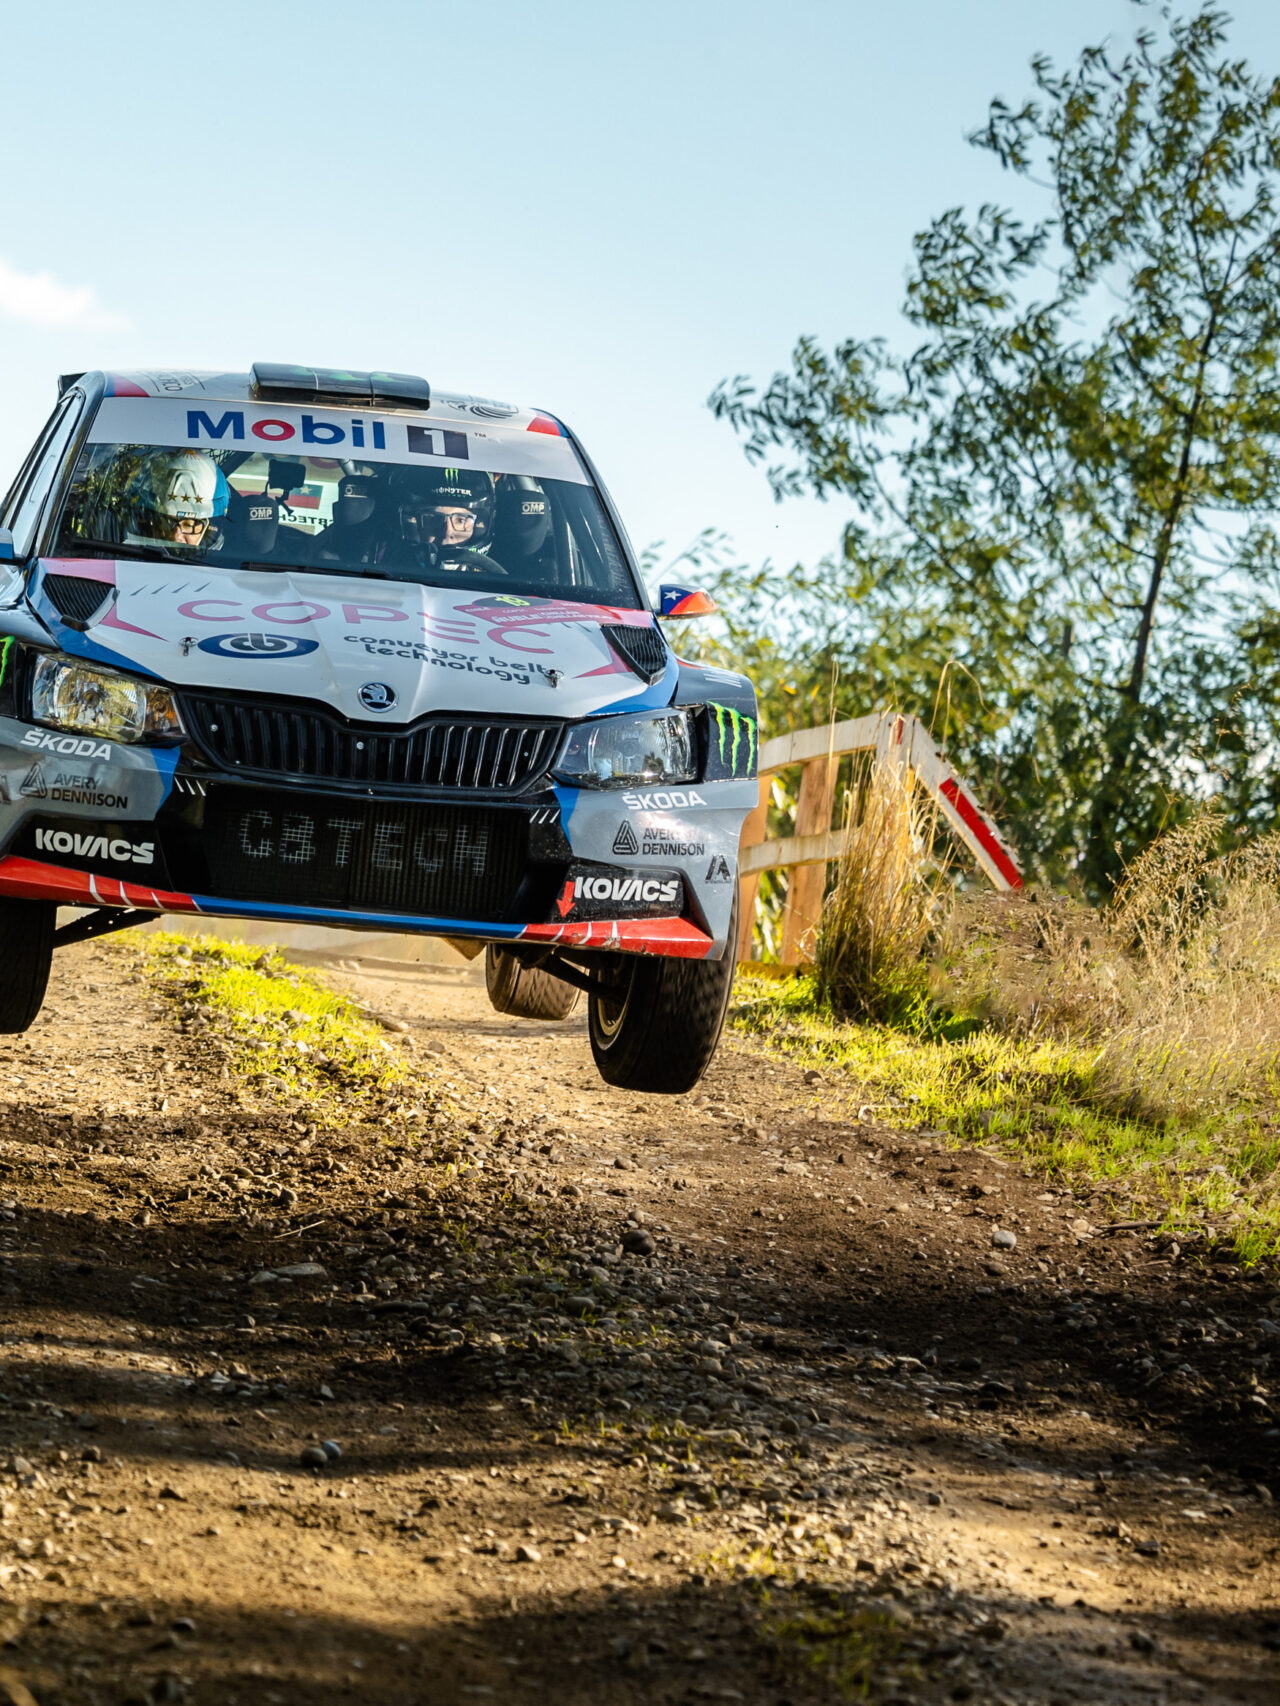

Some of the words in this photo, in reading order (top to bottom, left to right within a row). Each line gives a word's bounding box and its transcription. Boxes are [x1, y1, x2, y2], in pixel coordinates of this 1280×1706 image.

[187, 411, 386, 449] Mobil
[249, 508, 273, 518] OMP
[522, 503, 545, 513] OMP
[177, 600, 554, 655] COPEC
[365, 644, 531, 684] technology
[489, 656, 547, 674] belt
[20, 727, 112, 761] ŠKODA
[54, 773, 101, 790] AVERY
[51, 788, 128, 809] DENNISON
[621, 791, 708, 810] ŠKODA
[35, 828, 155, 865] KOVACS
[642, 843, 705, 856] DENNISON
[574, 876, 679, 902] KOVACS
